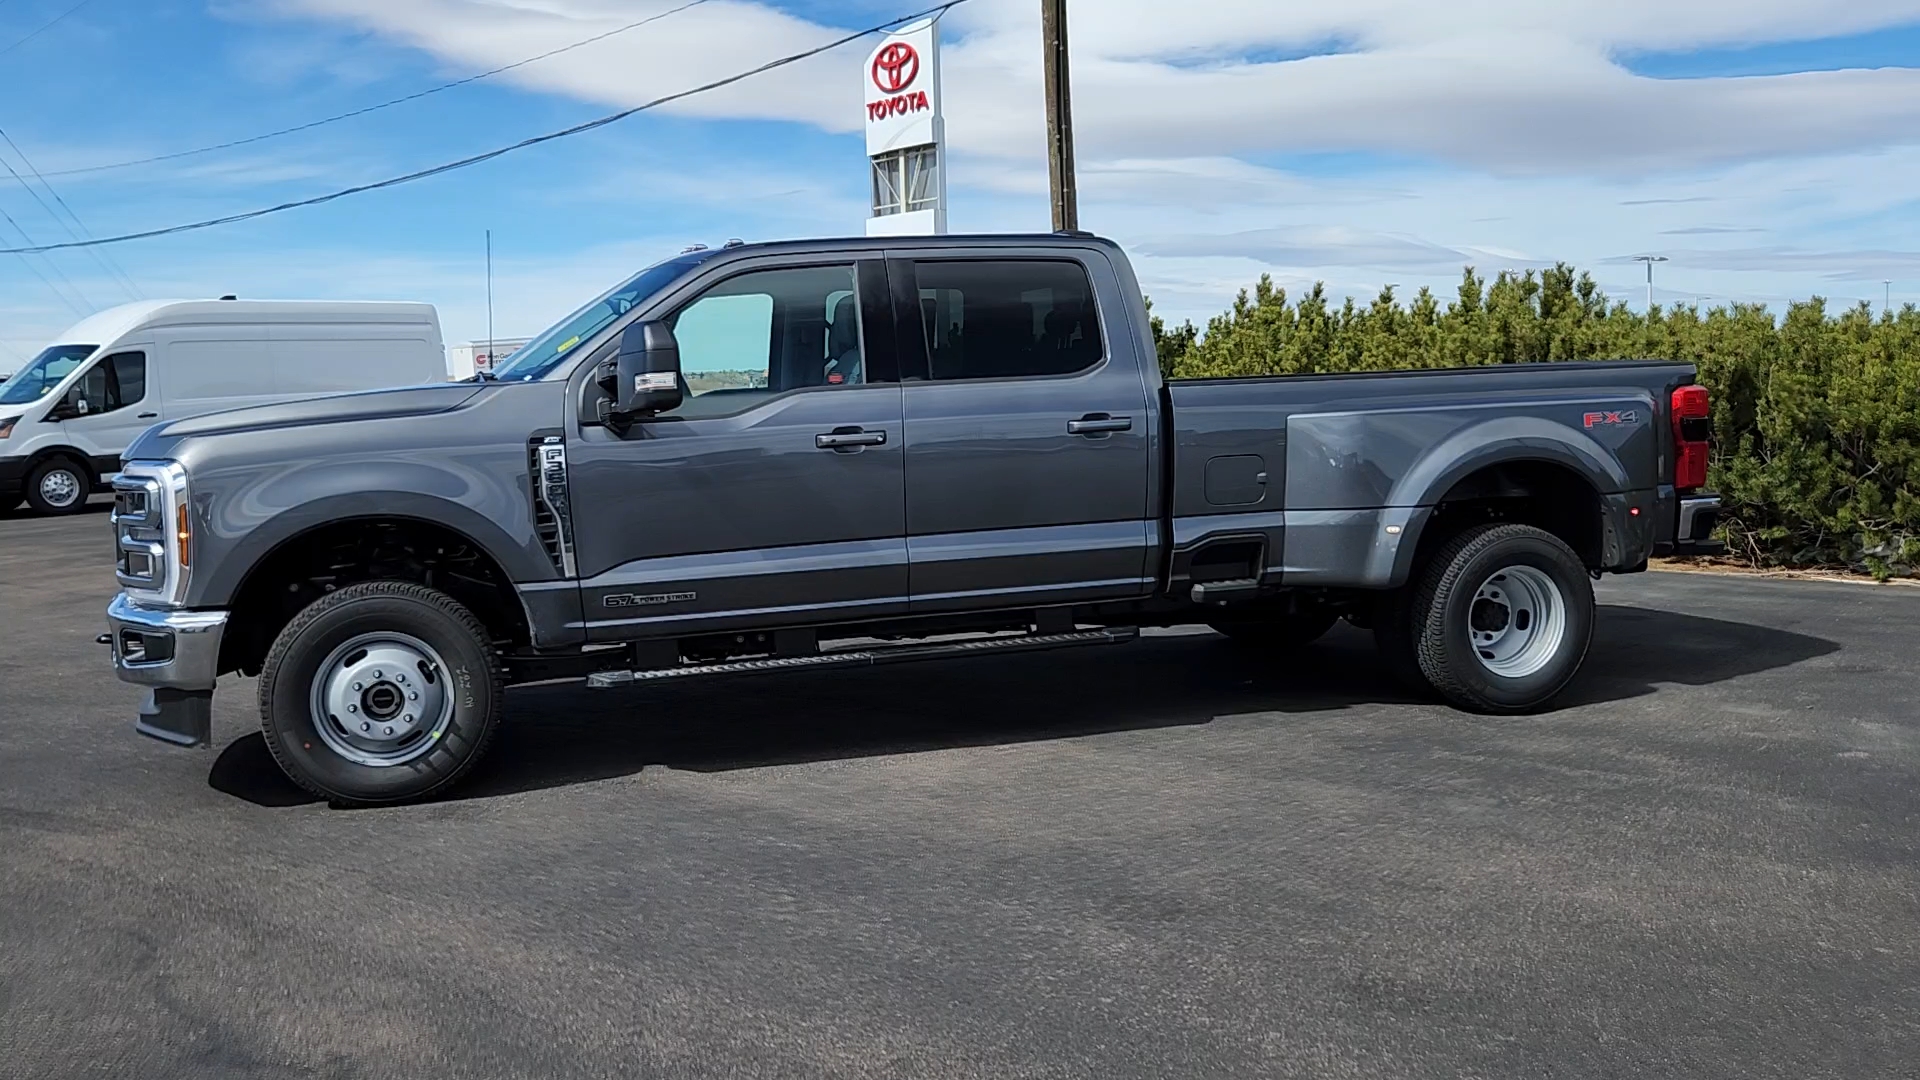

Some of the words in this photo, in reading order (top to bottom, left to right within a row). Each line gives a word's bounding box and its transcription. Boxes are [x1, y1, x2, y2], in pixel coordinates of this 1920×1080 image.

[866, 91, 930, 122] TOYOTA
[1583, 410, 1639, 429] FX4
[640, 595, 666, 604] POWER
[666, 593, 694, 601] STROKE
